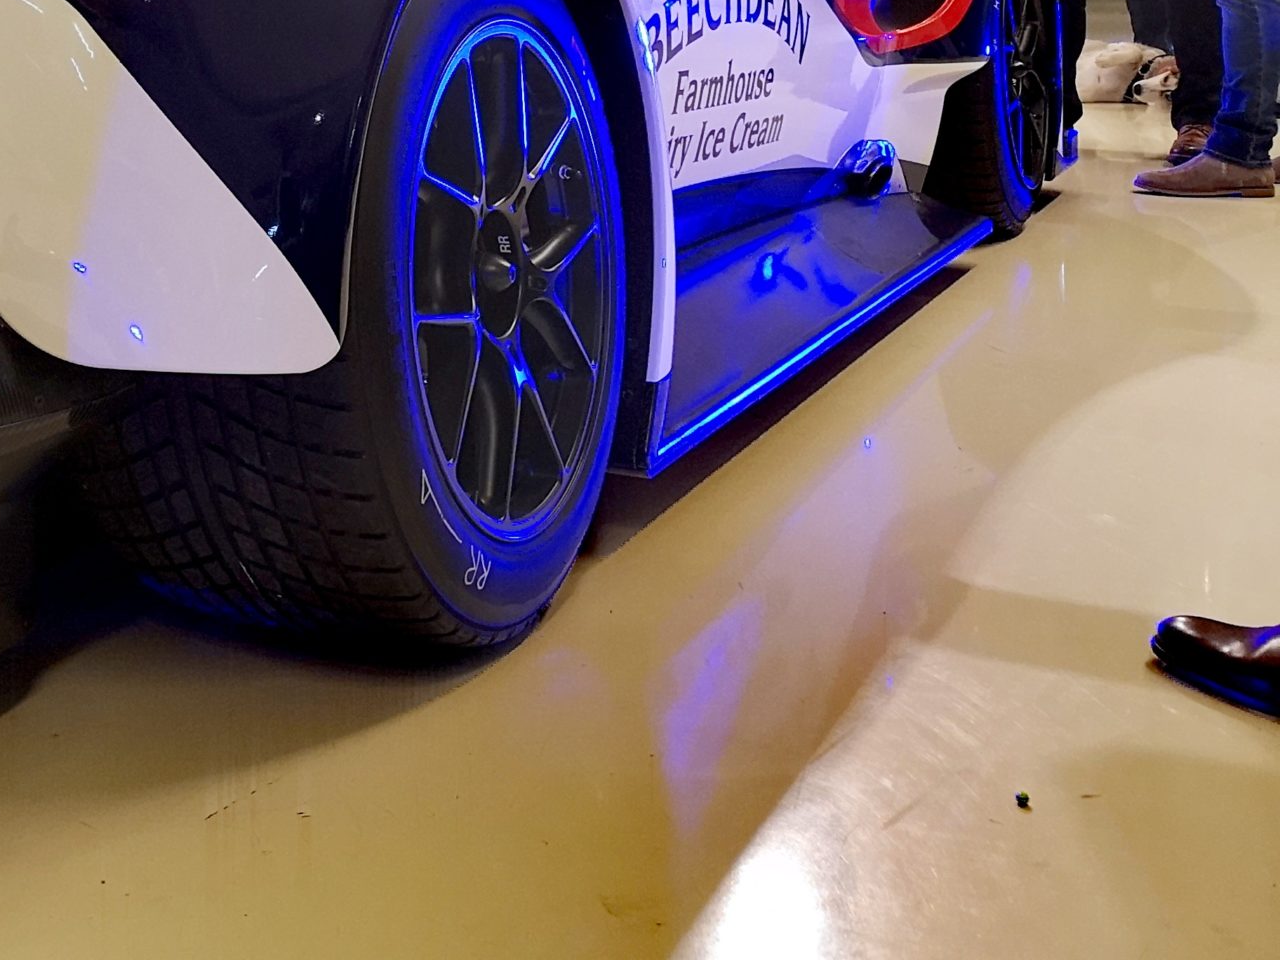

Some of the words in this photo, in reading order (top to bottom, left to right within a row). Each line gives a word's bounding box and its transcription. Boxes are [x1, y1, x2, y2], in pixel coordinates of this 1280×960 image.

[671, 58, 775, 116] Farmhouse
[667, 125, 693, 179] iry
[693, 121, 726, 164] Ice
[729, 111, 785, 154] Cream
[497, 235, 512, 254] RR
